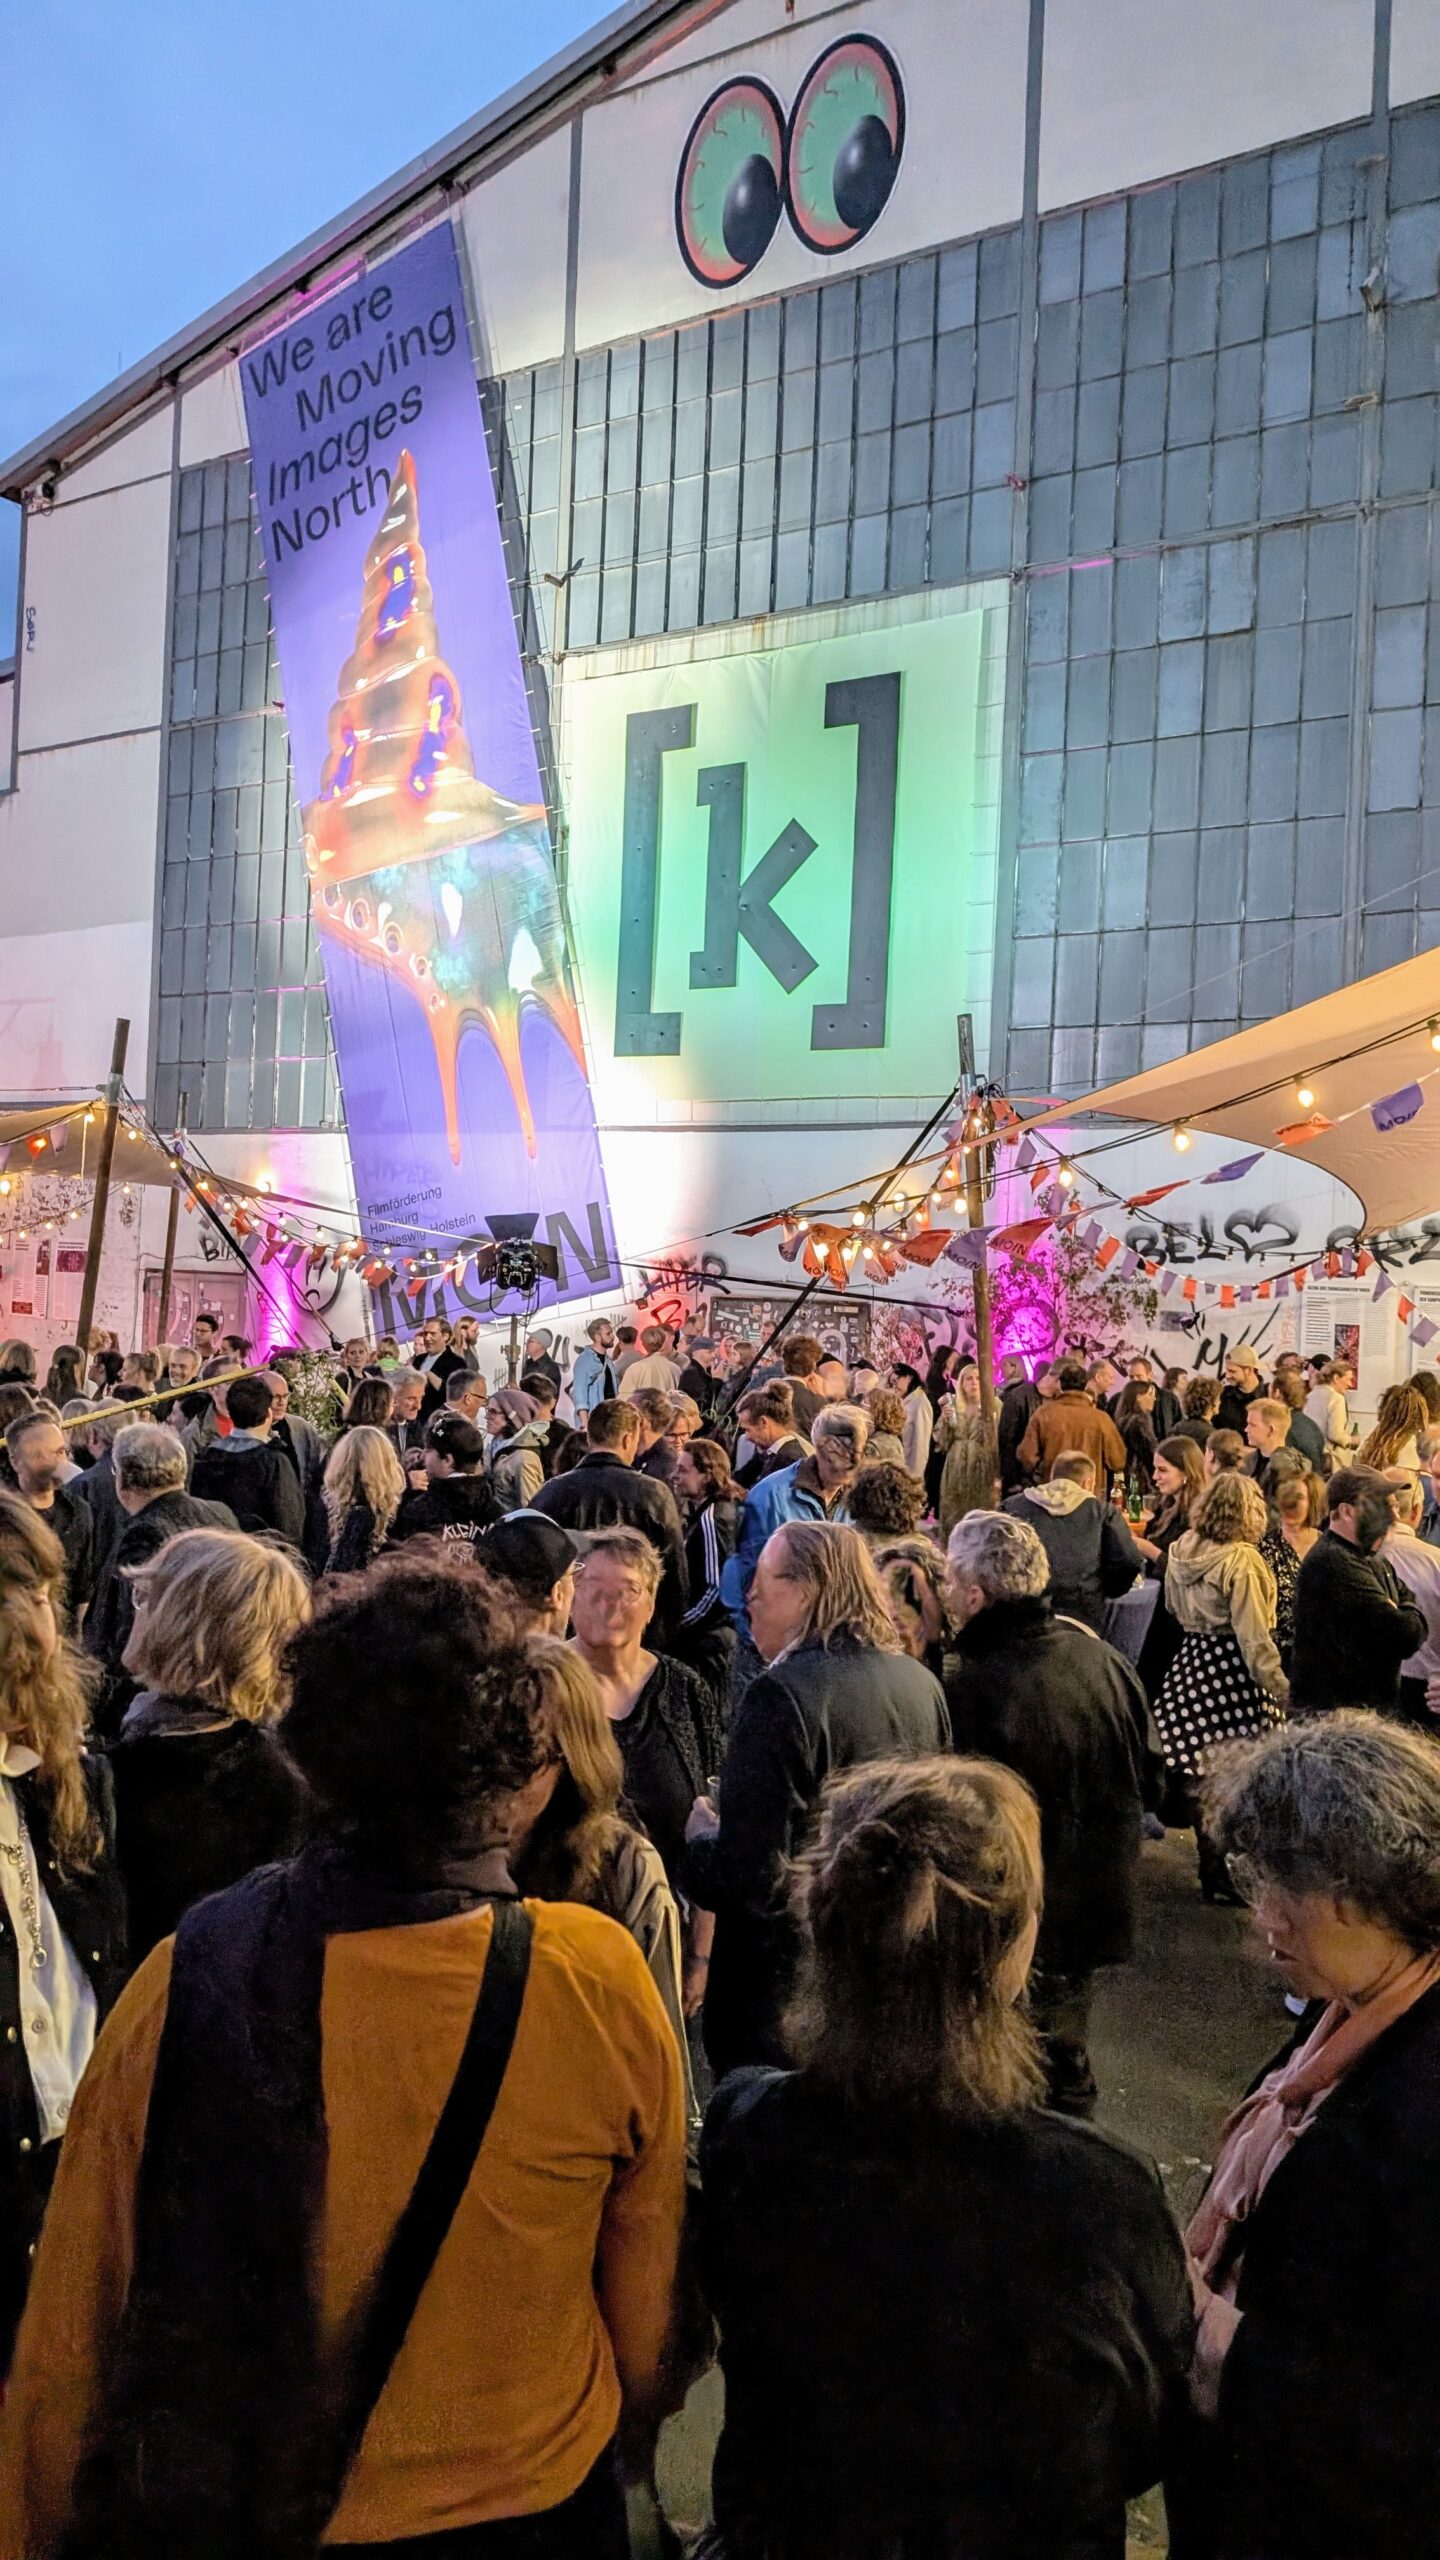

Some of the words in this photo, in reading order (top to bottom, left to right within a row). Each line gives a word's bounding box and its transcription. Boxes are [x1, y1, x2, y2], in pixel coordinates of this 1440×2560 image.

[247, 336, 316, 398] We
[327, 283, 393, 351] are
[295, 304, 456, 432] Moving
[267, 384, 423, 507] Images
[271, 464, 391, 563] North
[367, 1186, 442, 1217] Filmförderung
[901, 1248, 933, 1267] MOIN
[944, 1248, 982, 1270] MOIN
[989, 1237, 1029, 1256] MOIN
[864, 1270, 889, 1285] MOIN
